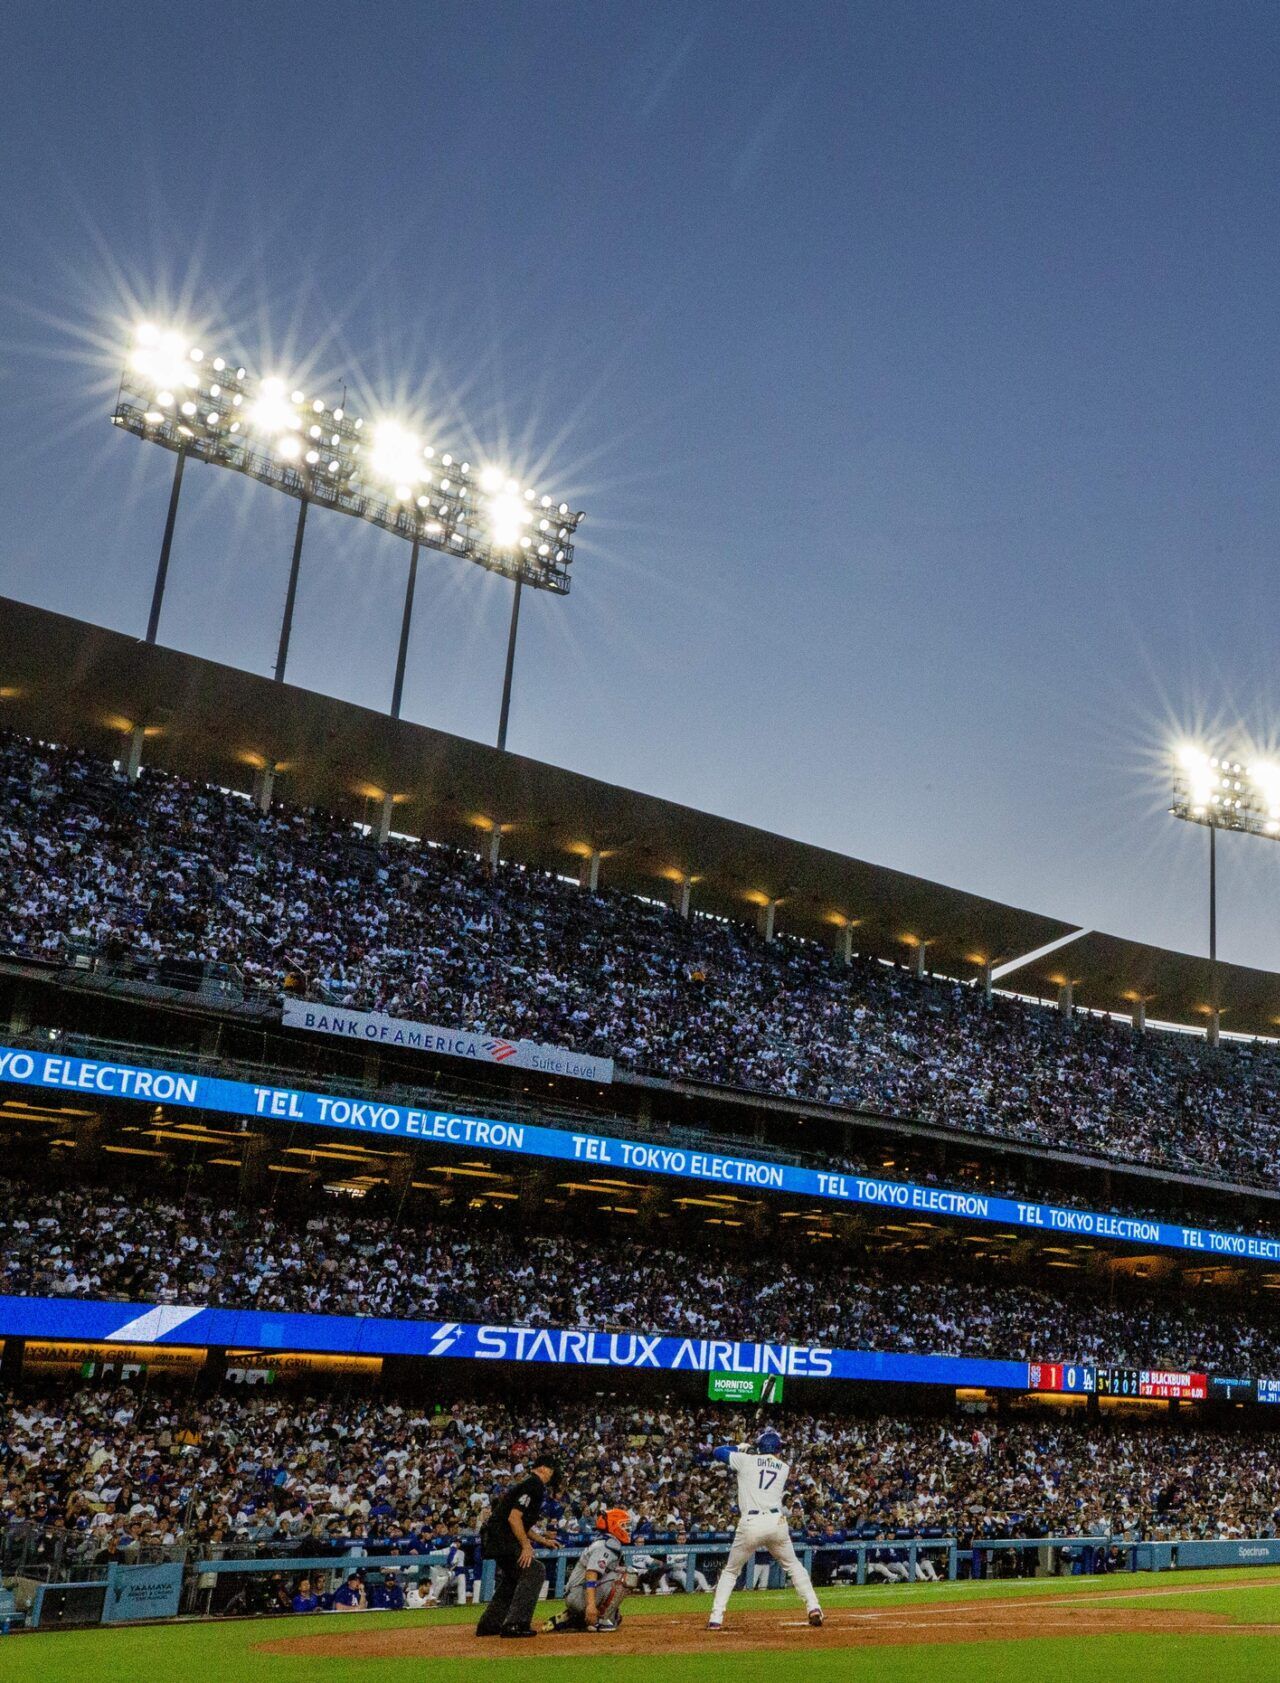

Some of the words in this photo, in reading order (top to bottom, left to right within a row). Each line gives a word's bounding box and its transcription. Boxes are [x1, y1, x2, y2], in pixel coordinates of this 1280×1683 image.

[304, 1013, 358, 1035] BANK
[364, 1024, 389, 1039] OF
[393, 1029, 477, 1057] AMERICA
[532, 1055, 564, 1072] Suite
[566, 1060, 597, 1078] Level
[43, 1058, 198, 1103] ELECTRON
[254, 1088, 304, 1118] TEL
[316, 1098, 399, 1131] TOKYO
[406, 1112, 525, 1148] ELECTRON
[572, 1136, 611, 1162] TEL
[621, 1144, 687, 1172] TOKYO
[690, 1155, 784, 1187] ELECTRON
[817, 1174, 849, 1197] TEL
[856, 1180, 909, 1205] TOKYO
[913, 1189, 989, 1217] ELECTRON
[1017, 1204, 1043, 1225] TEL
[1050, 1209, 1094, 1232] TOKYO
[1096, 1217, 1160, 1242] ELECTRON
[1182, 1229, 1204, 1248] TEL
[1209, 1233, 1246, 1253] TOKYO
[475, 1326, 661, 1367] STARLUX
[671, 1338, 833, 1376] AIRLINES
[714, 1380, 754, 1389] HORNITOS
[1051, 1367, 1056, 1388] 1
[1067, 1368, 1076, 1388] 0
[1113, 1379, 1119, 1393] 2
[1122, 1380, 1128, 1393] 0
[1131, 1381, 1137, 1394] 2
[1141, 1371, 1150, 1384] 58
[1151, 1372, 1190, 1386] BLACKBURN
[1259, 1380, 1266, 1391] 17
[757, 1458, 782, 1470] OHTANI
[759, 1470, 777, 1490] 17
[1238, 1546, 1270, 1558] Spectrum
